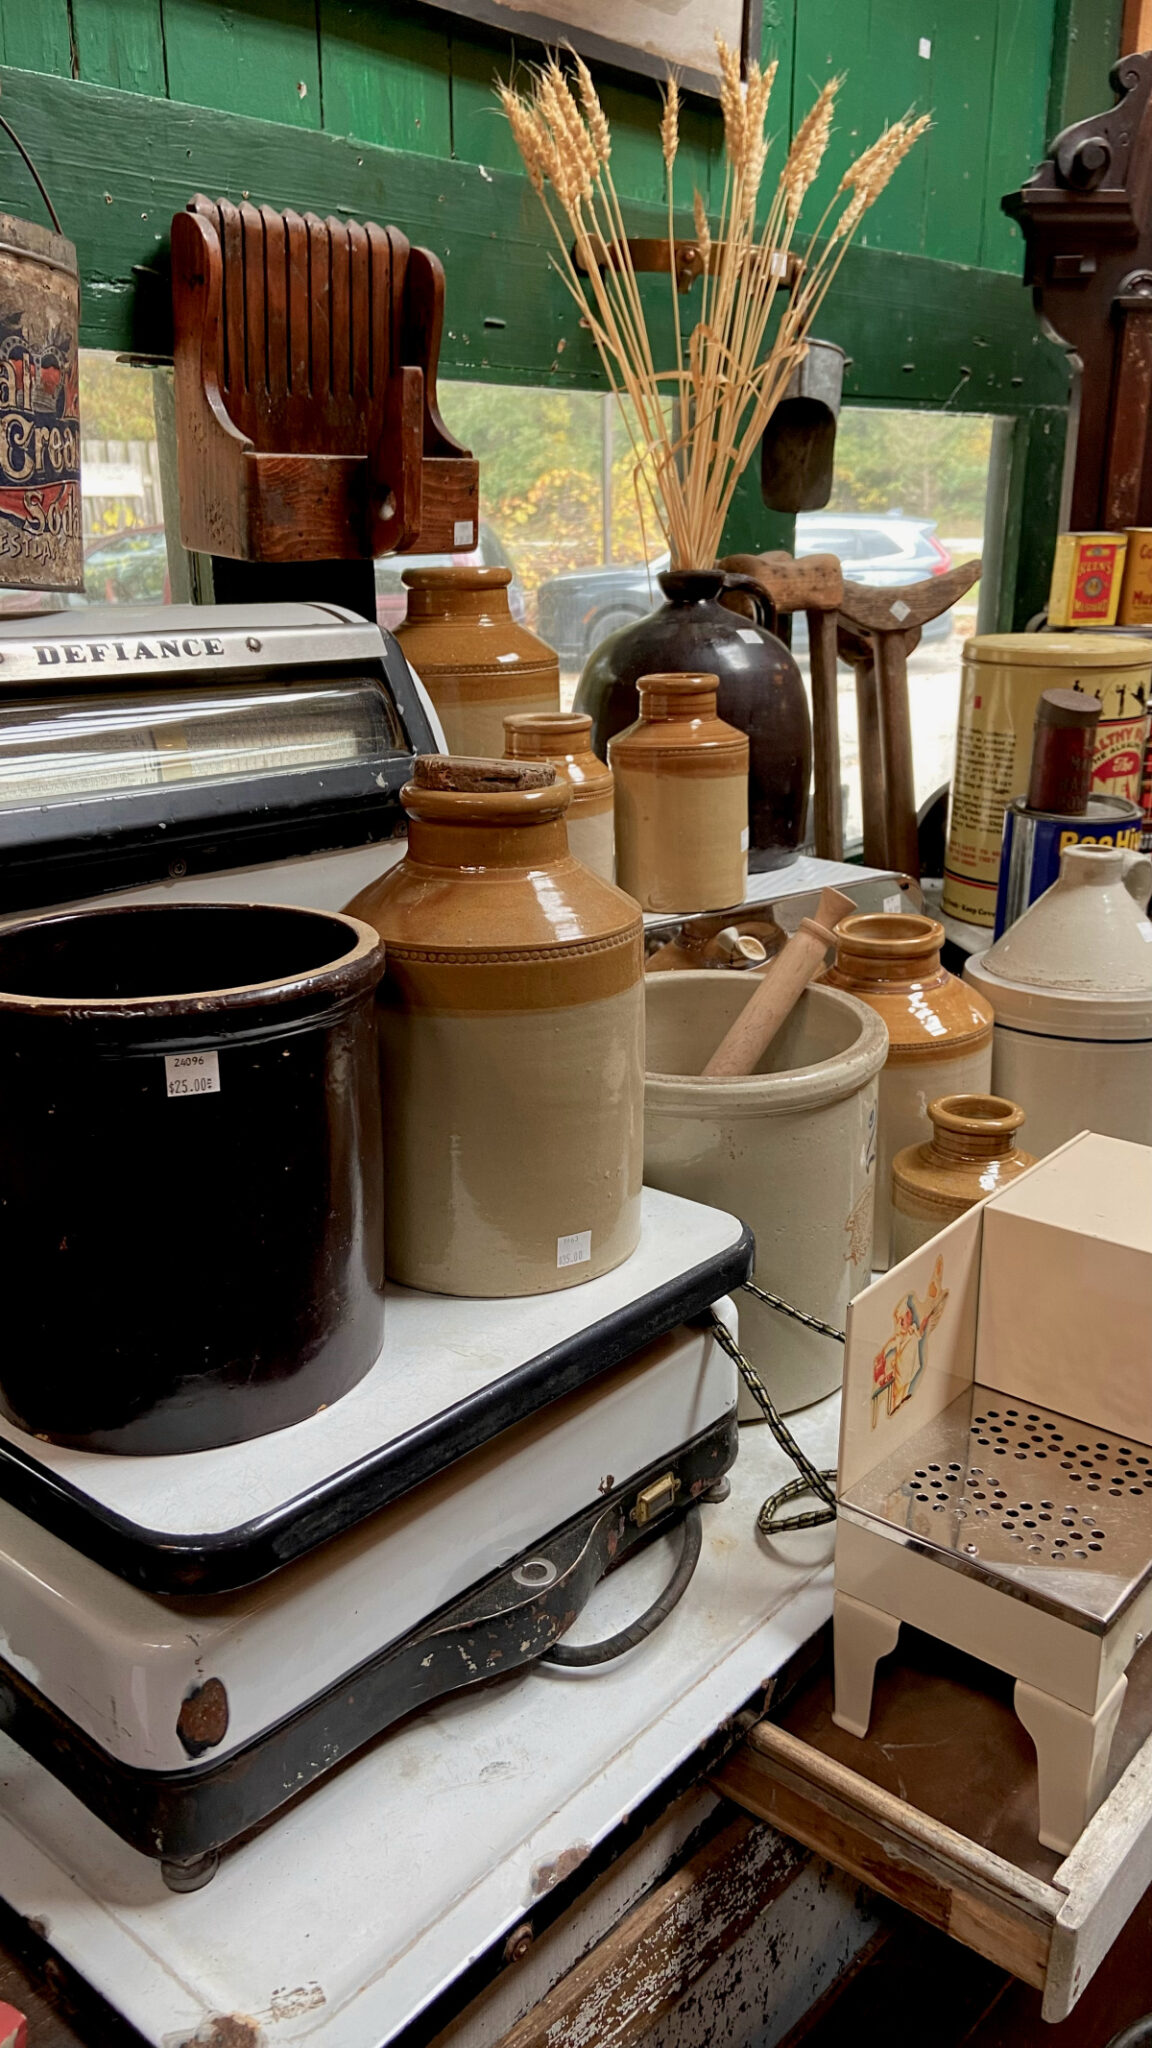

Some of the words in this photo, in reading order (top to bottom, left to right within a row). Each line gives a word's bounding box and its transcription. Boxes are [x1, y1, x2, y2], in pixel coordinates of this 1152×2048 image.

[0, 413, 80, 480] Crea
[23, 490, 80, 538] Soda
[32, 637, 225, 665] DEFIANCE
[174, 1056, 204, 1067] 24096
